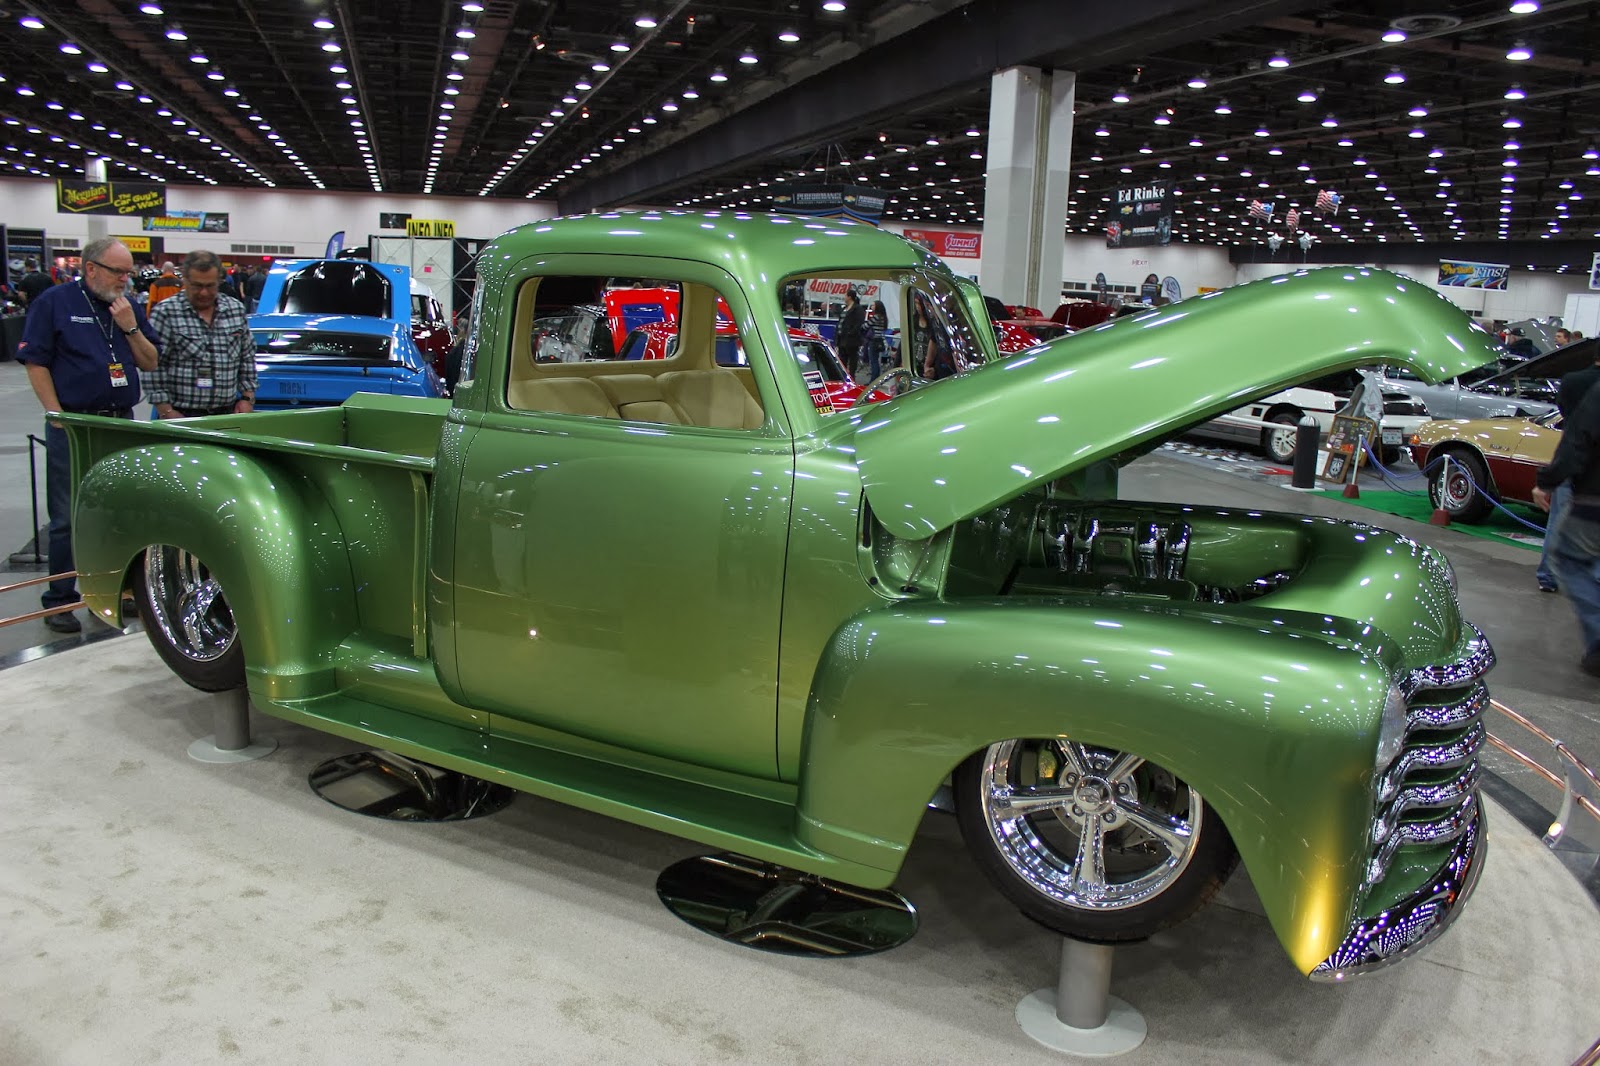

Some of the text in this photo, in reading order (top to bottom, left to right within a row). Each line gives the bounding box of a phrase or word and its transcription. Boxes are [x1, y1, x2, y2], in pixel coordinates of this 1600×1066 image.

[113, 191, 158, 207] Car Guy's
[1118, 186, 1166, 203] Ed Rinke
[118, 197, 163, 214] Car Wax!
[408, 222, 431, 237] INFO
[434, 222, 454, 238] INFO
[810, 393, 829, 404] TOP
